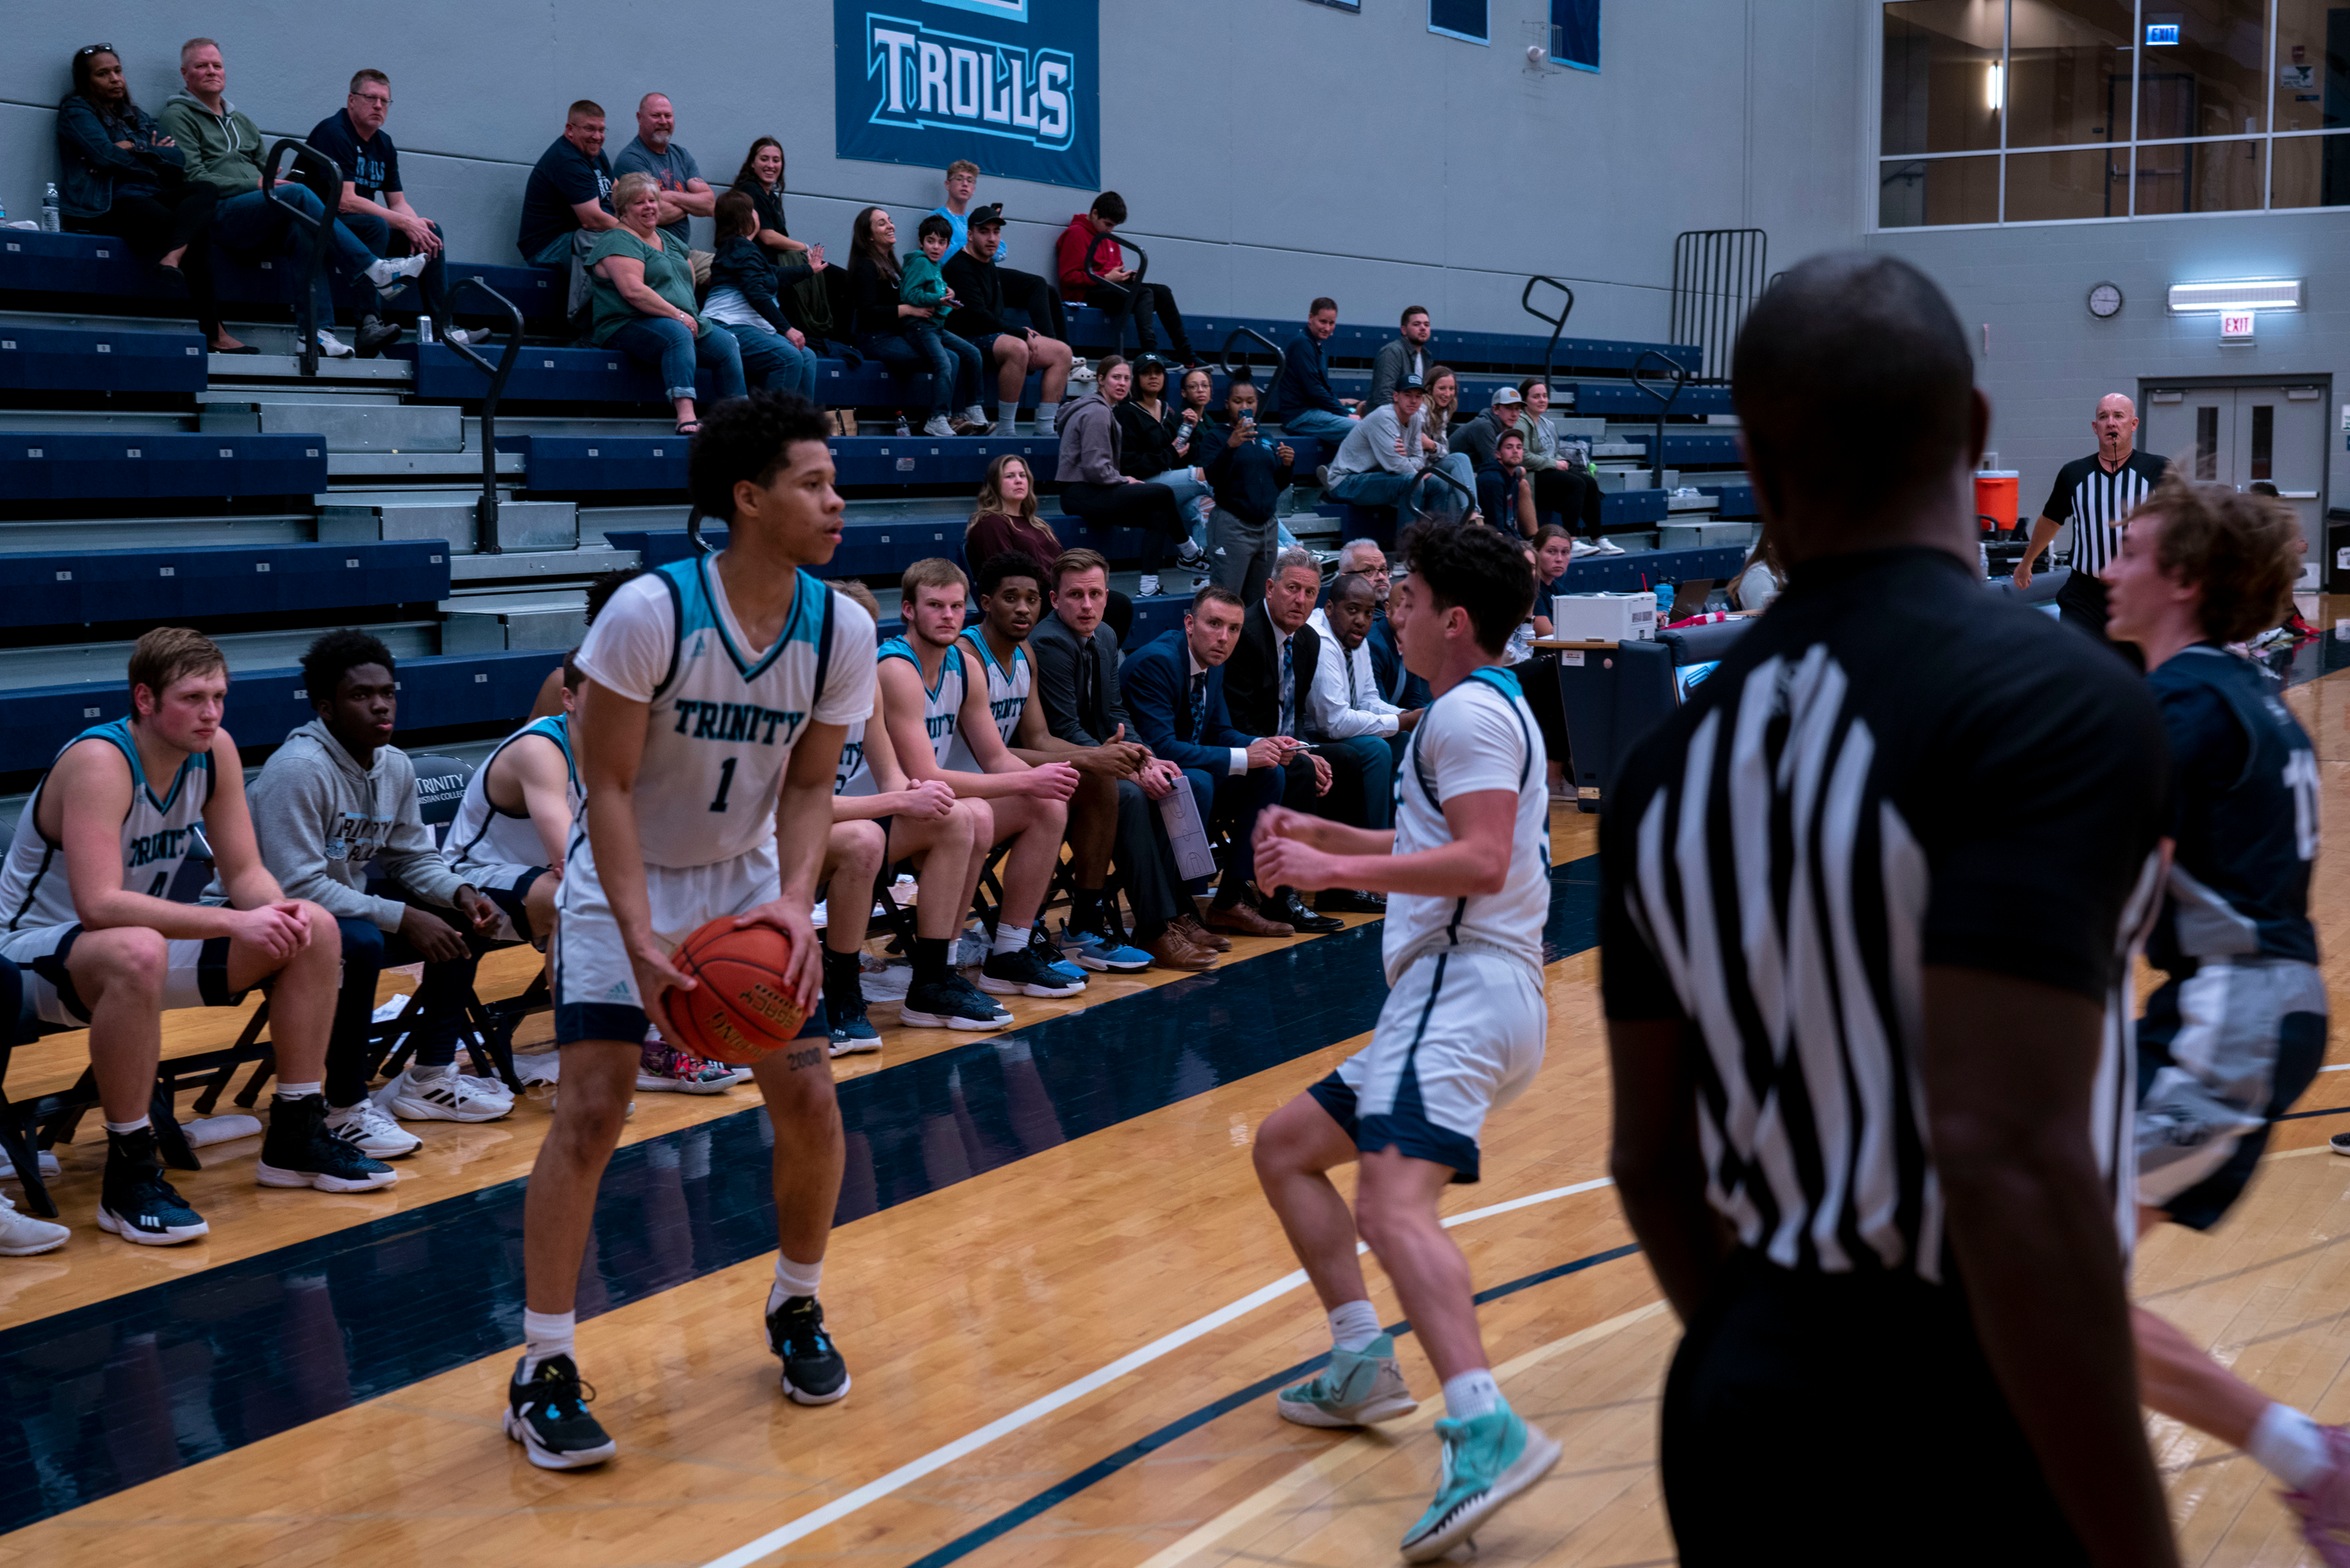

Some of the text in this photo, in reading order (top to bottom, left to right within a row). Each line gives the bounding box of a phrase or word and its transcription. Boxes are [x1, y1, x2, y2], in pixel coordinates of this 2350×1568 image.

[2152, 27, 2175, 42] EXIT
[874, 28, 1068, 139] TROLLS
[2225, 317, 2249, 333] EXIT
[674, 699, 805, 745] TRINITY
[416, 773, 464, 794] TRINITY
[709, 757, 738, 812] 1
[440, 789, 466, 801] COLLEG
